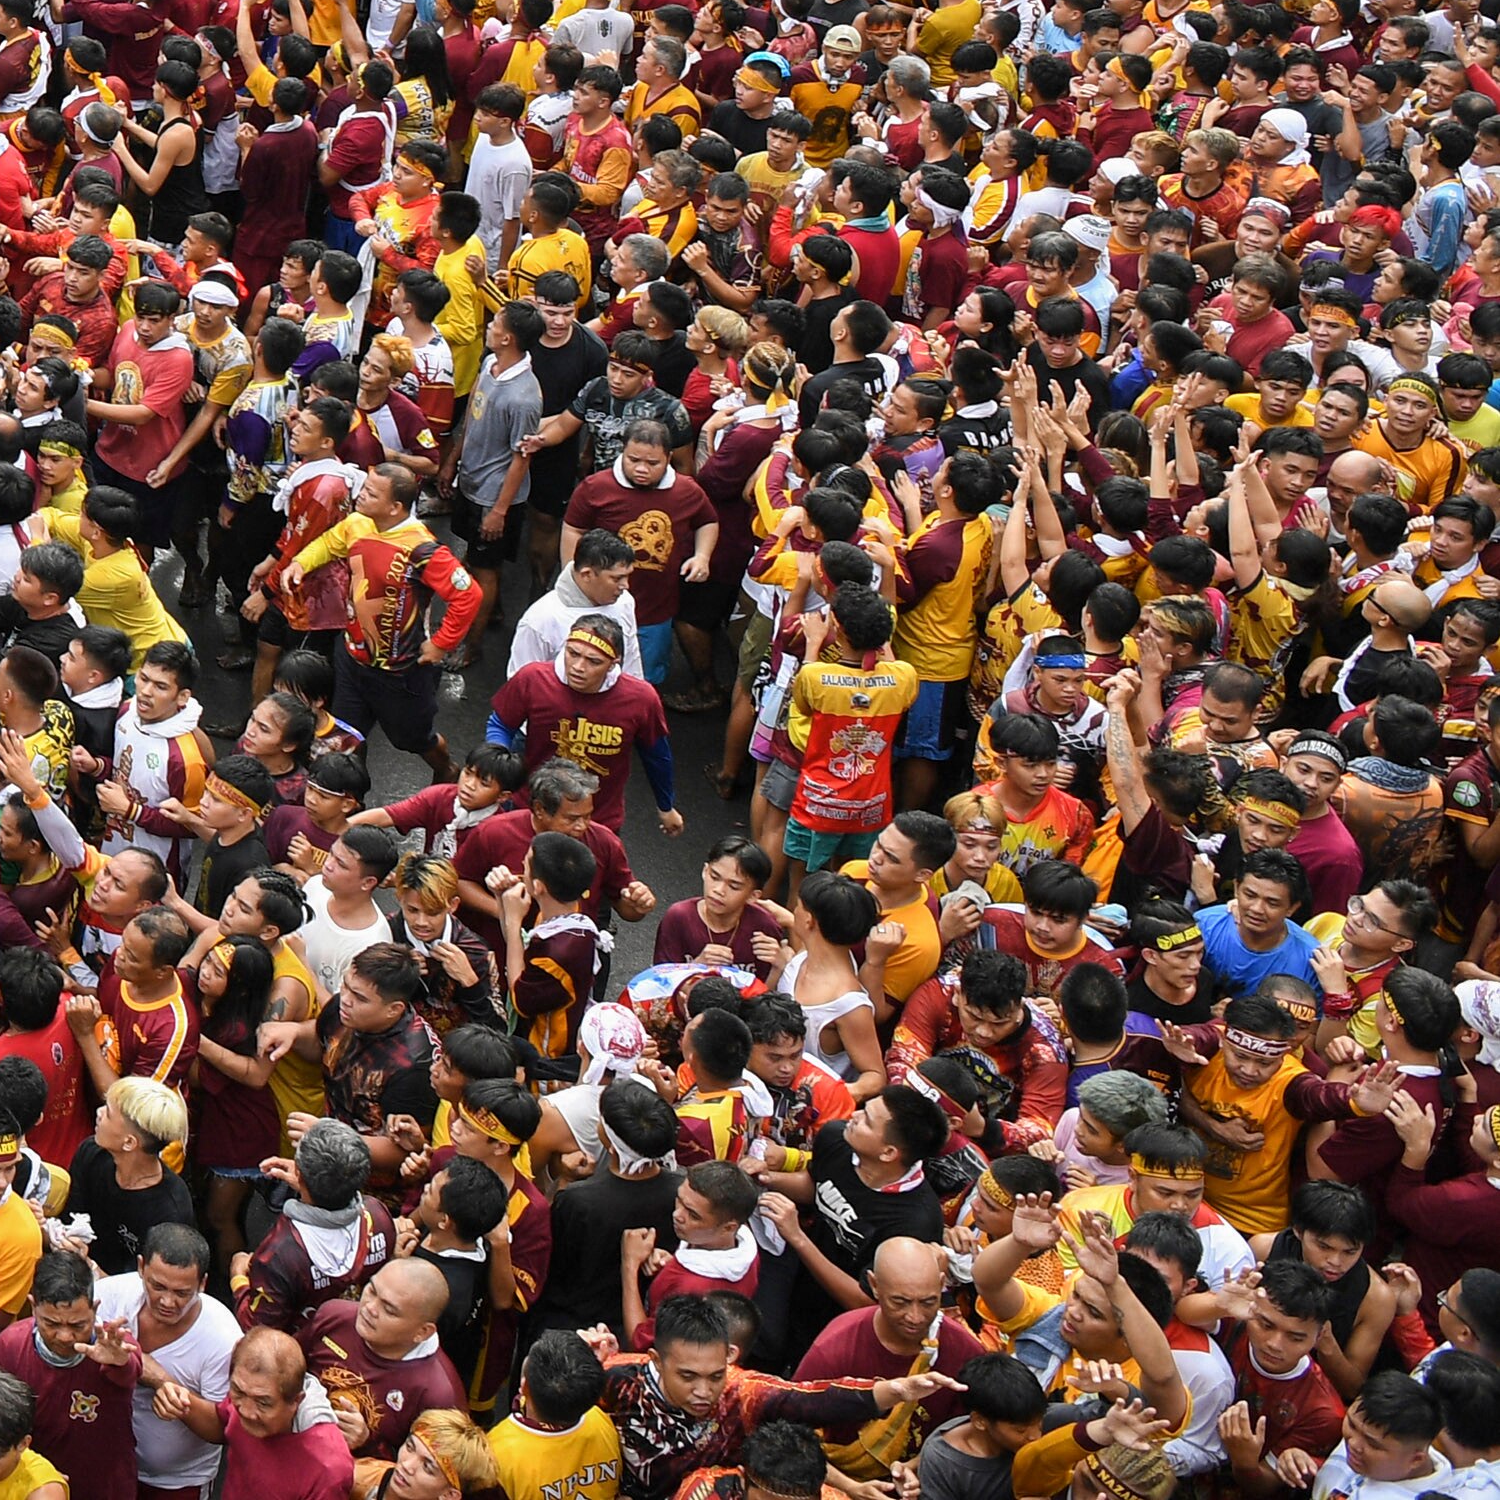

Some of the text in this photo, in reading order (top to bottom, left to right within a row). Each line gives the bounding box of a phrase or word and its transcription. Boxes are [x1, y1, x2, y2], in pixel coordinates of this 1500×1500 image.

[570, 717, 624, 747] JESUS
[818, 1180, 858, 1224] NIKE
[540, 1459, 619, 1500] NPJN
